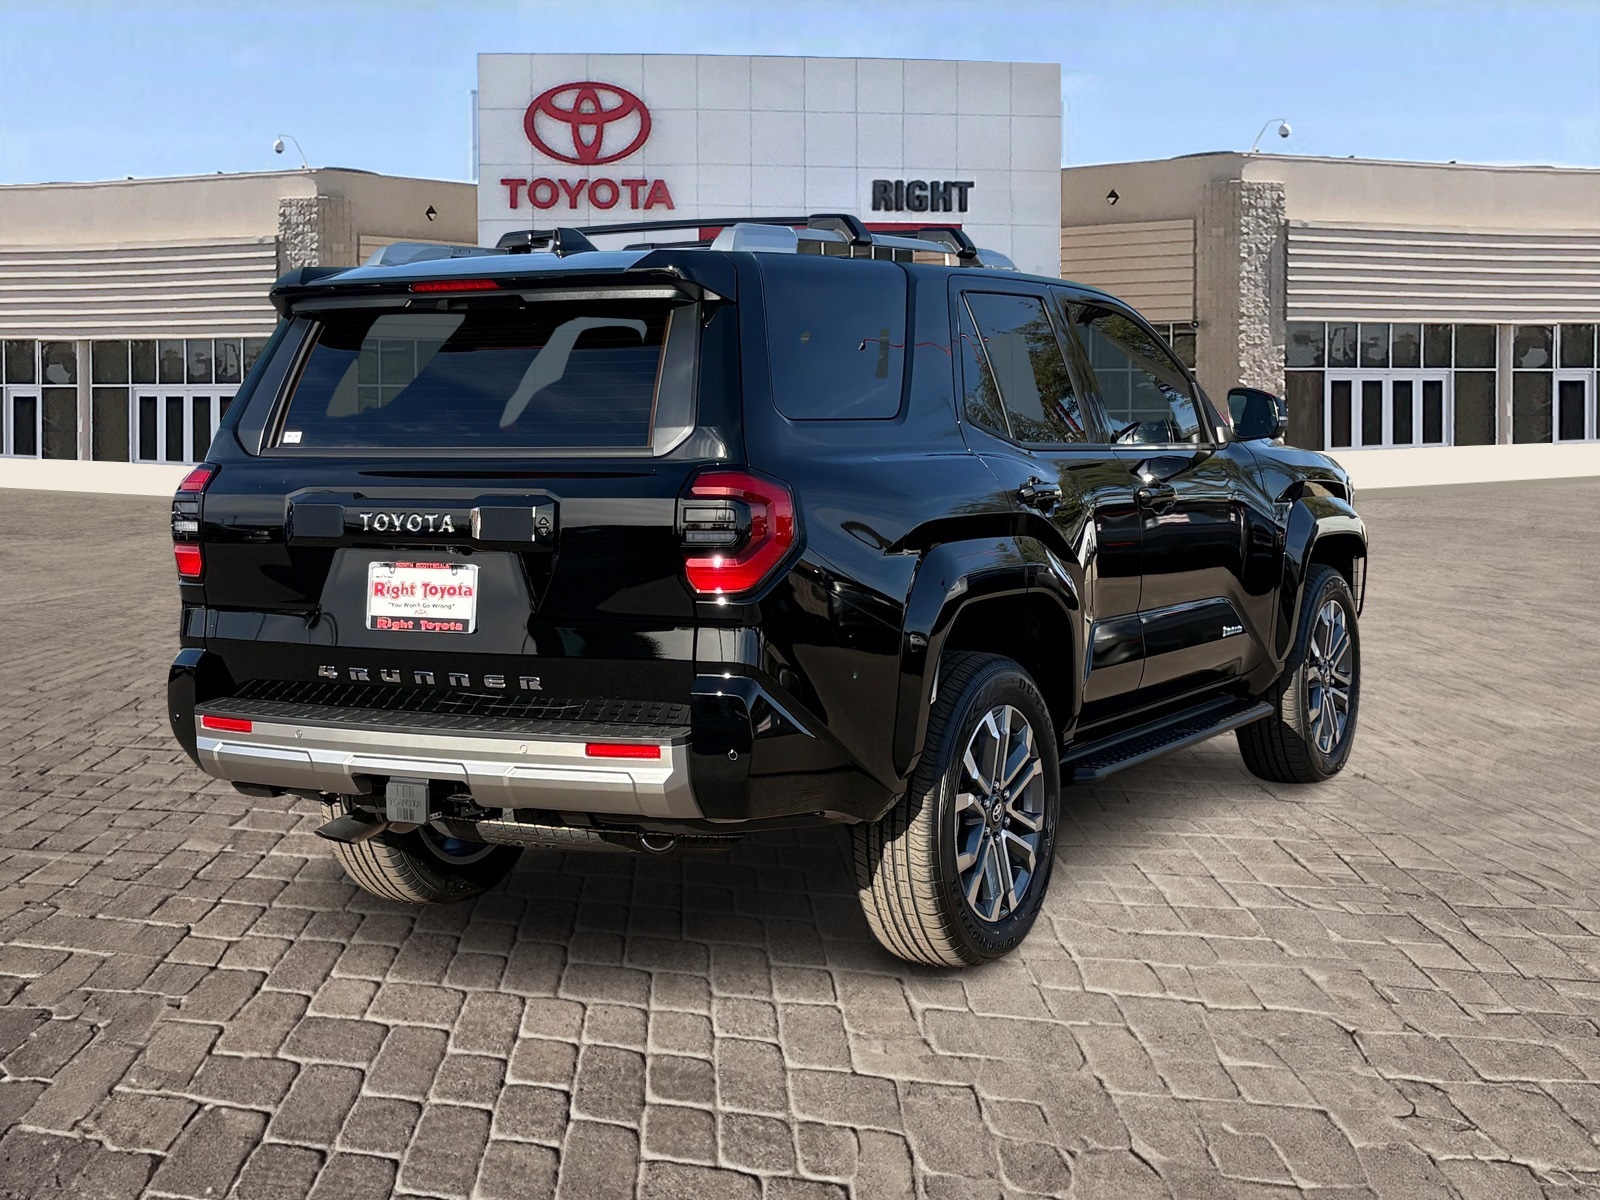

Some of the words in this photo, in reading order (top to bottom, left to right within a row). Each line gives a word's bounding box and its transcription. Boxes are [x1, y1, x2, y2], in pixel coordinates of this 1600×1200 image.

[500, 178, 675, 211] TOYOTA
[872, 179, 975, 213] RIGHT
[359, 511, 455, 534] TOYOTA
[373, 581, 416, 599] Right
[421, 582, 473, 600] Toyota
[376, 617, 414, 630] Right
[420, 620, 463, 631] Toyota
[317, 664, 544, 691] 4RUNNER
[389, 798, 422, 808] TOYOTA
